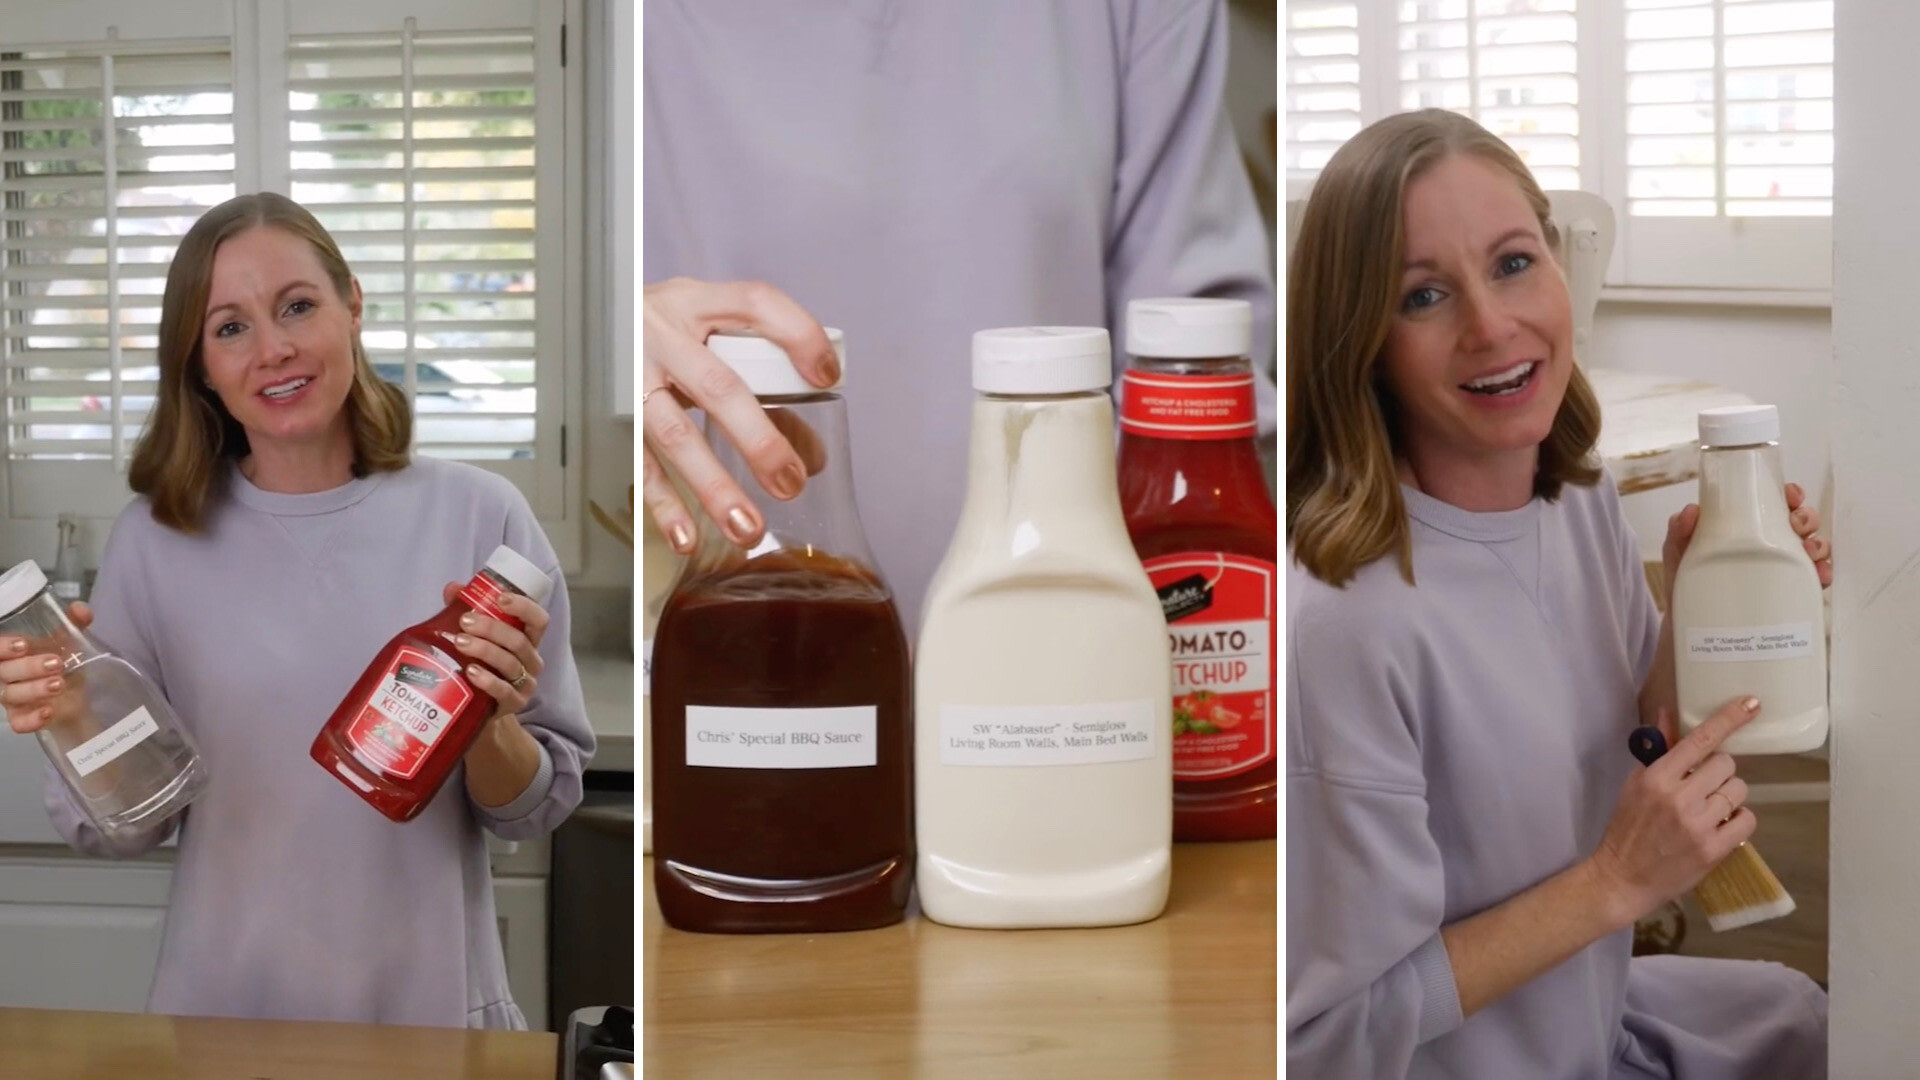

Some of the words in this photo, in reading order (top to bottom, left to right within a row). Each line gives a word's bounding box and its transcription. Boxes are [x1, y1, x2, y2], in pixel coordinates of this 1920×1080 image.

[1174, 660, 1248, 686] TCHUP
[389, 682, 439, 720] TOMATO
[380, 696, 429, 733] KETCHUP
[973, 724, 992, 735] SW
[1072, 720, 1127, 735] Semigloss
[739, 732, 786, 747] Special
[791, 732, 820, 745] BBQ
[824, 731, 863, 744] Sauce
[950, 737, 985, 750] Living
[988, 738, 1022, 749] Room
[1025, 738, 1060, 749] Walls,
[1064, 736, 1093, 747] Main
[1095, 734, 1117, 746] Bed
[1120, 731, 1149, 744] Walls
